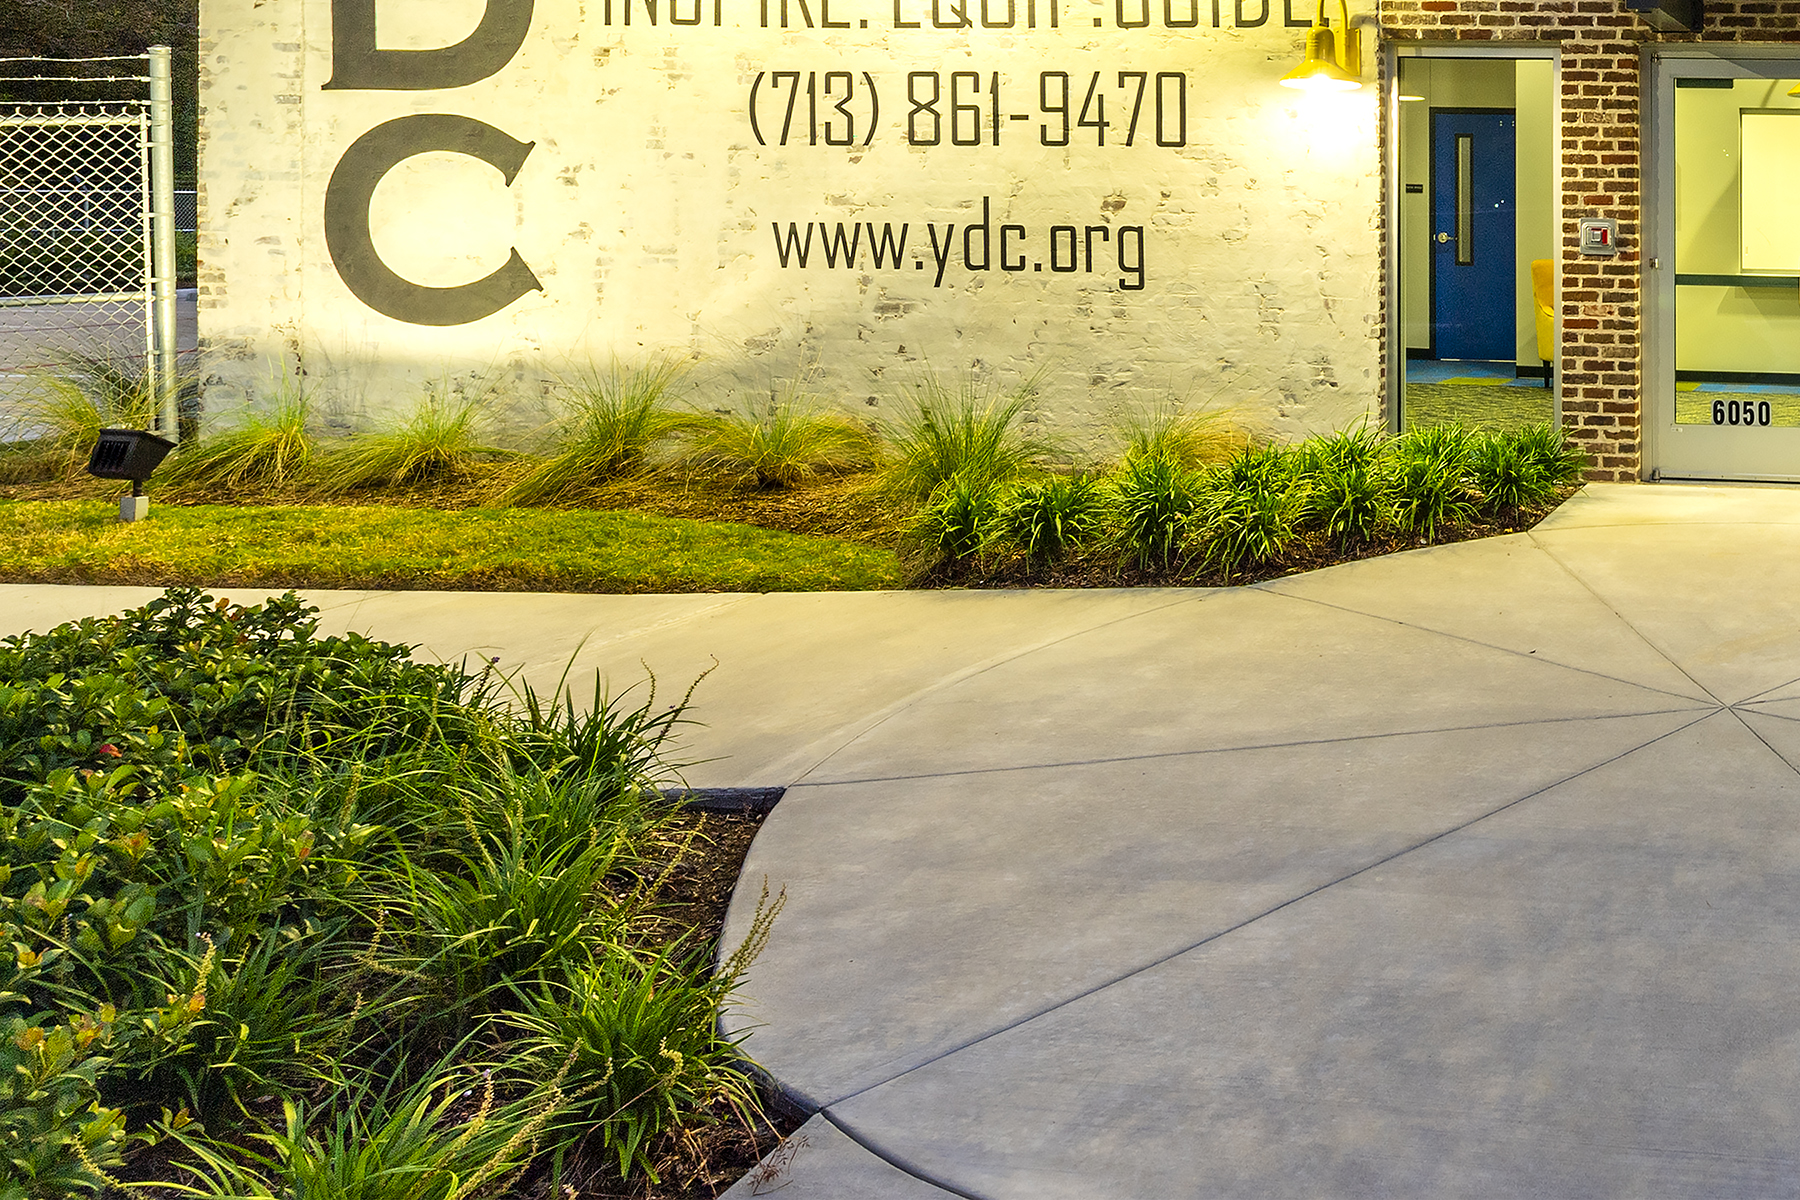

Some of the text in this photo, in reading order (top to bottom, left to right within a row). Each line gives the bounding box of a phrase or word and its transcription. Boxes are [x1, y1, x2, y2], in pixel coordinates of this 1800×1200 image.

[749, 71, 1187, 148] (713) 861-9470
[771, 196, 1146, 291] www.ydc.org
[1712, 400, 1771, 426] 6050
